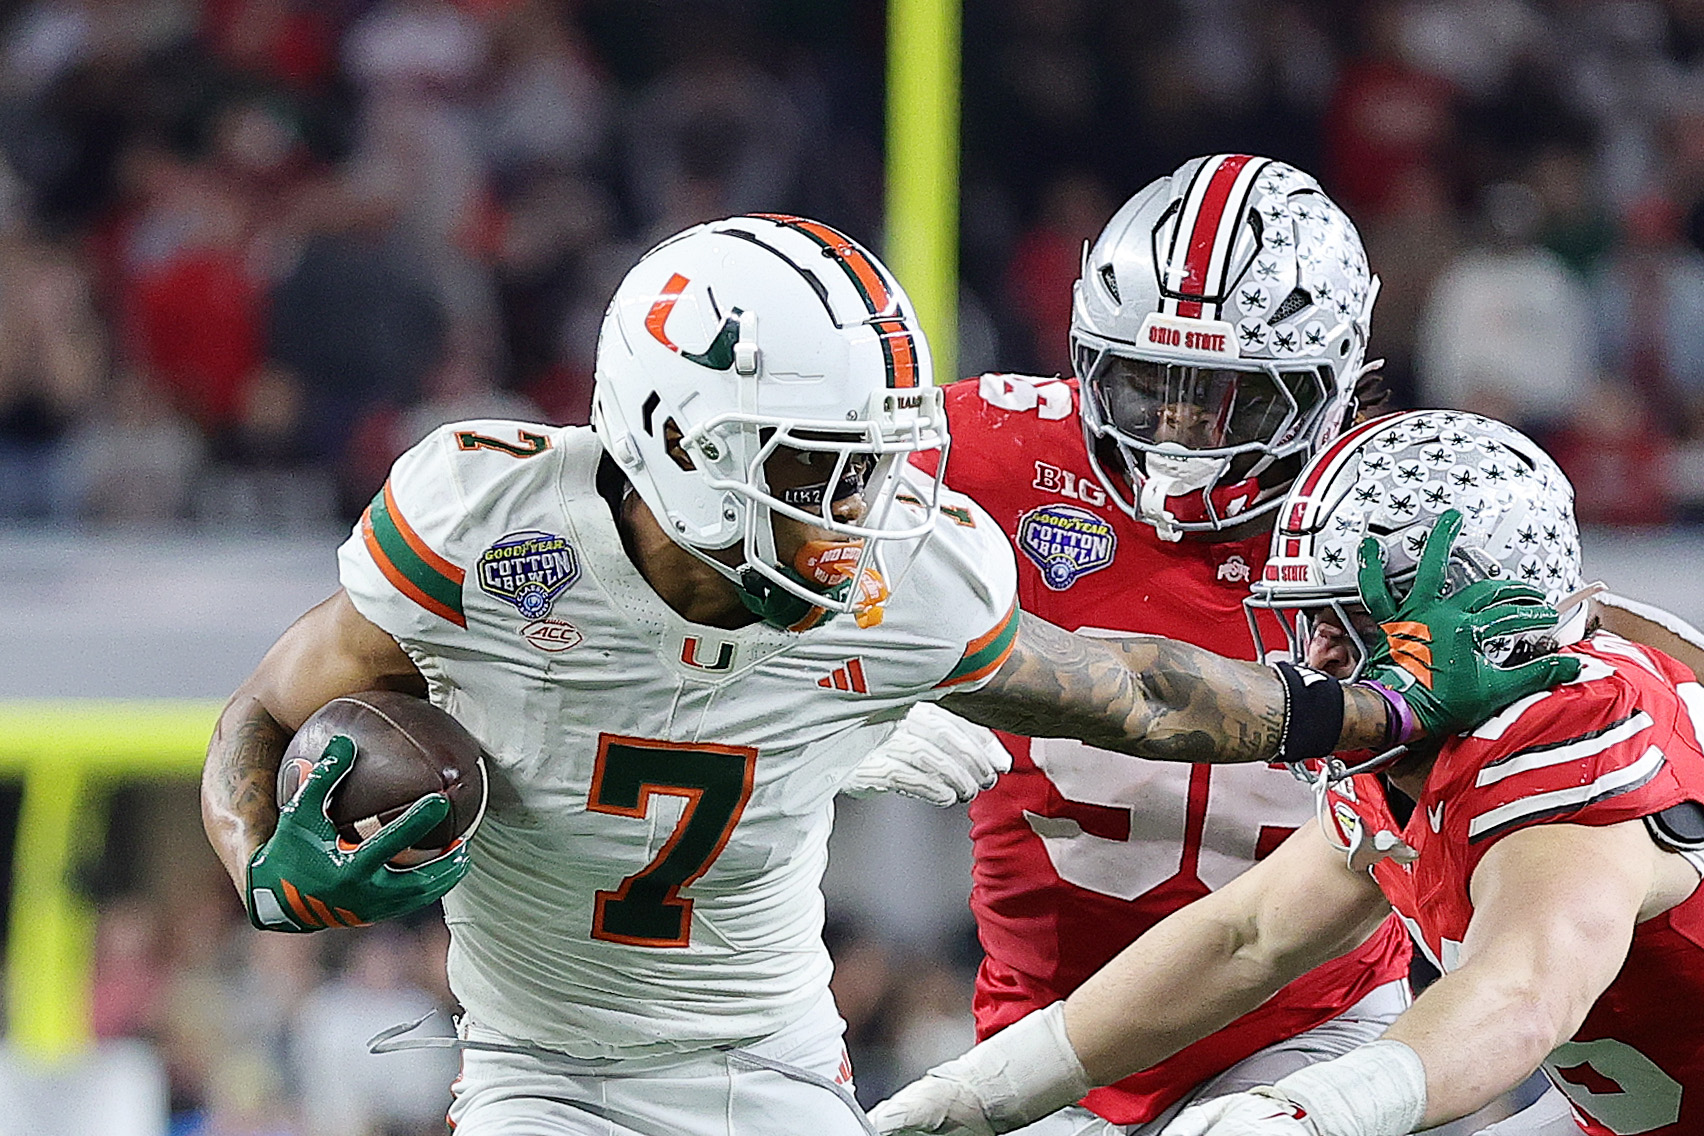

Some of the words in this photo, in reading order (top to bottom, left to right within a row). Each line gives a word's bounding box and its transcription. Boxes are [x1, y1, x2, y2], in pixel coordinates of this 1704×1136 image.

[1149, 325, 1180, 347] OHIO
[1184, 331, 1226, 352] STATE
[454, 428, 554, 459] 7
[485, 539, 565, 561] GOODYEAR
[1026, 521, 1108, 562] COTTON
[1038, 540, 1090, 565] BOWL
[484, 551, 571, 588] COTTON
[502, 569, 557, 592] BOWL
[530, 626, 576, 641] ACC
[679, 634, 738, 673] U
[586, 731, 759, 948] 7
